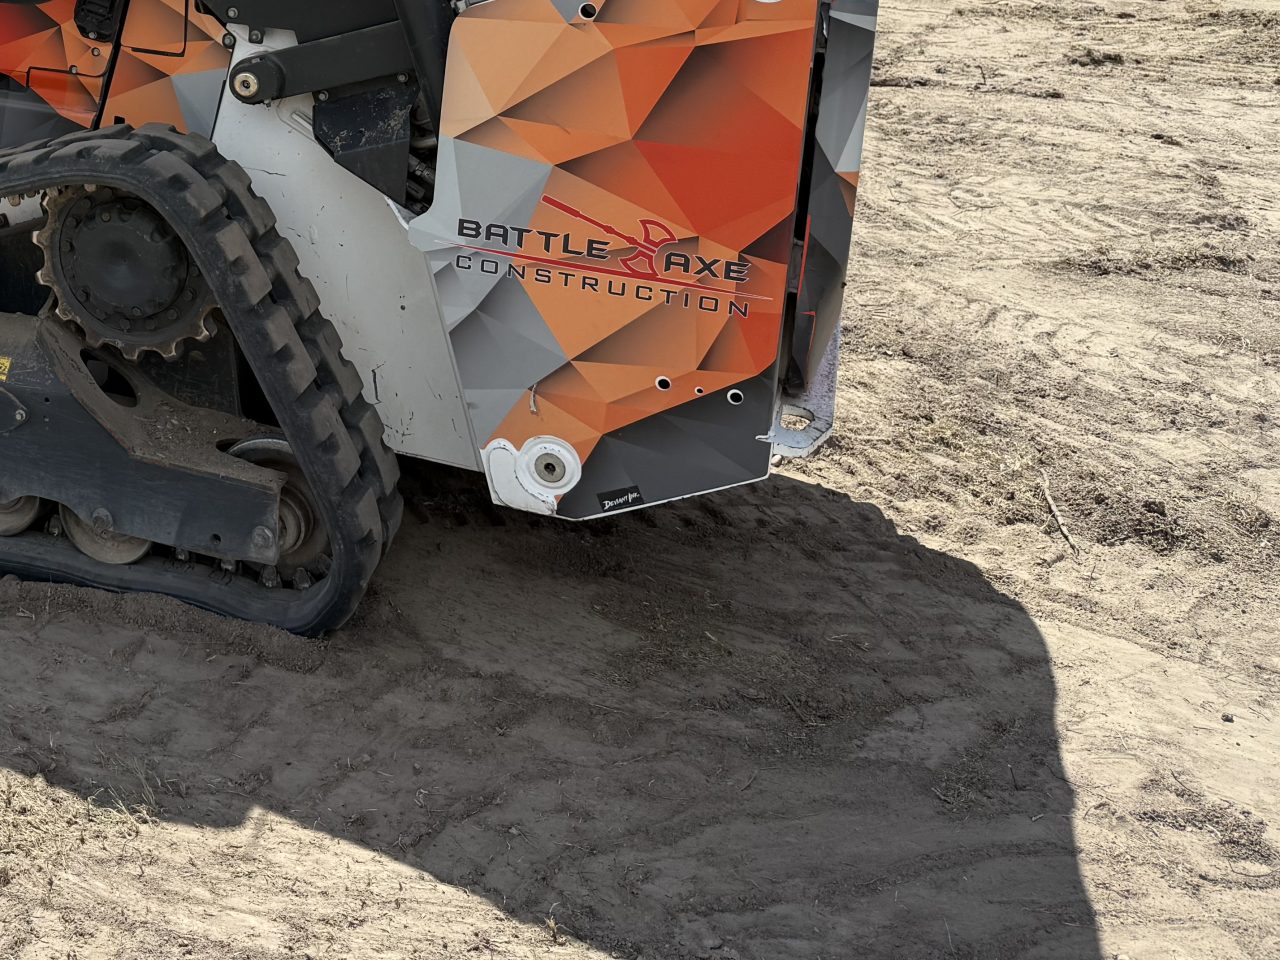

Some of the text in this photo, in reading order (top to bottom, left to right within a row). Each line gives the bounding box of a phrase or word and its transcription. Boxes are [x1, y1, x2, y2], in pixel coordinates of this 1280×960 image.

[457, 218, 751, 282] BATTLE AXE
[455, 254, 749, 318] CONSTRUCTION
